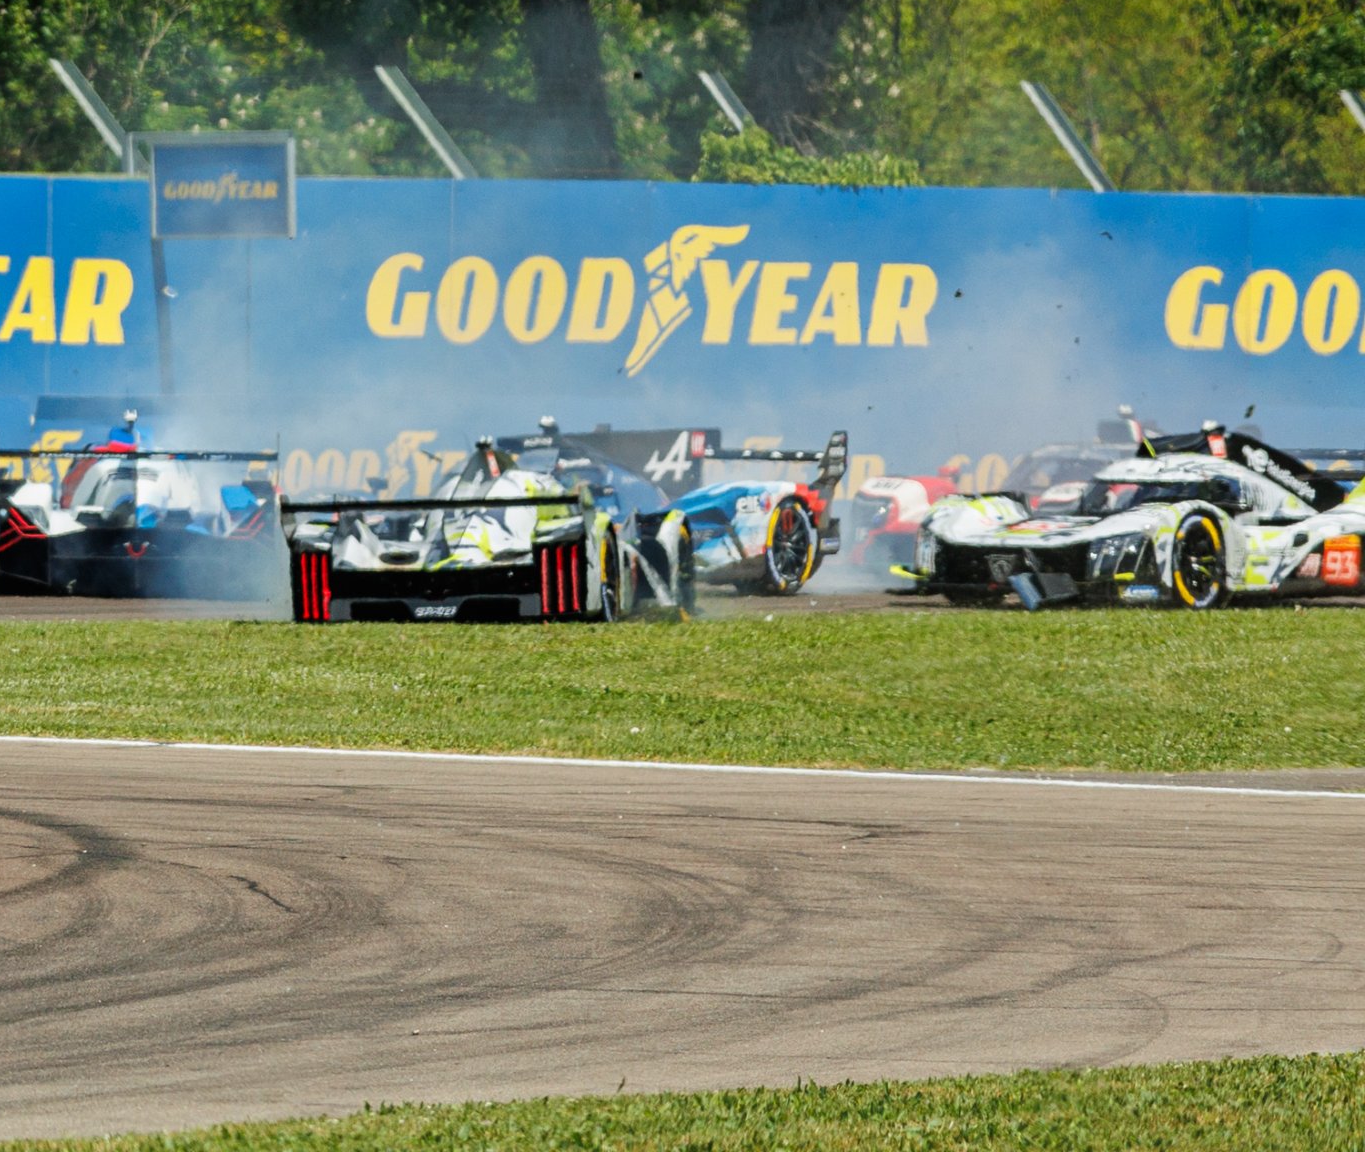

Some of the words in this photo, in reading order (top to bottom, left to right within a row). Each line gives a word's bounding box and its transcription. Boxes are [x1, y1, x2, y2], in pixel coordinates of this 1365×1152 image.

[163, 180, 279, 200] GOODYEAR
[364, 251, 939, 347] GOODYEAR
[1325, 550, 1360, 580] 93
